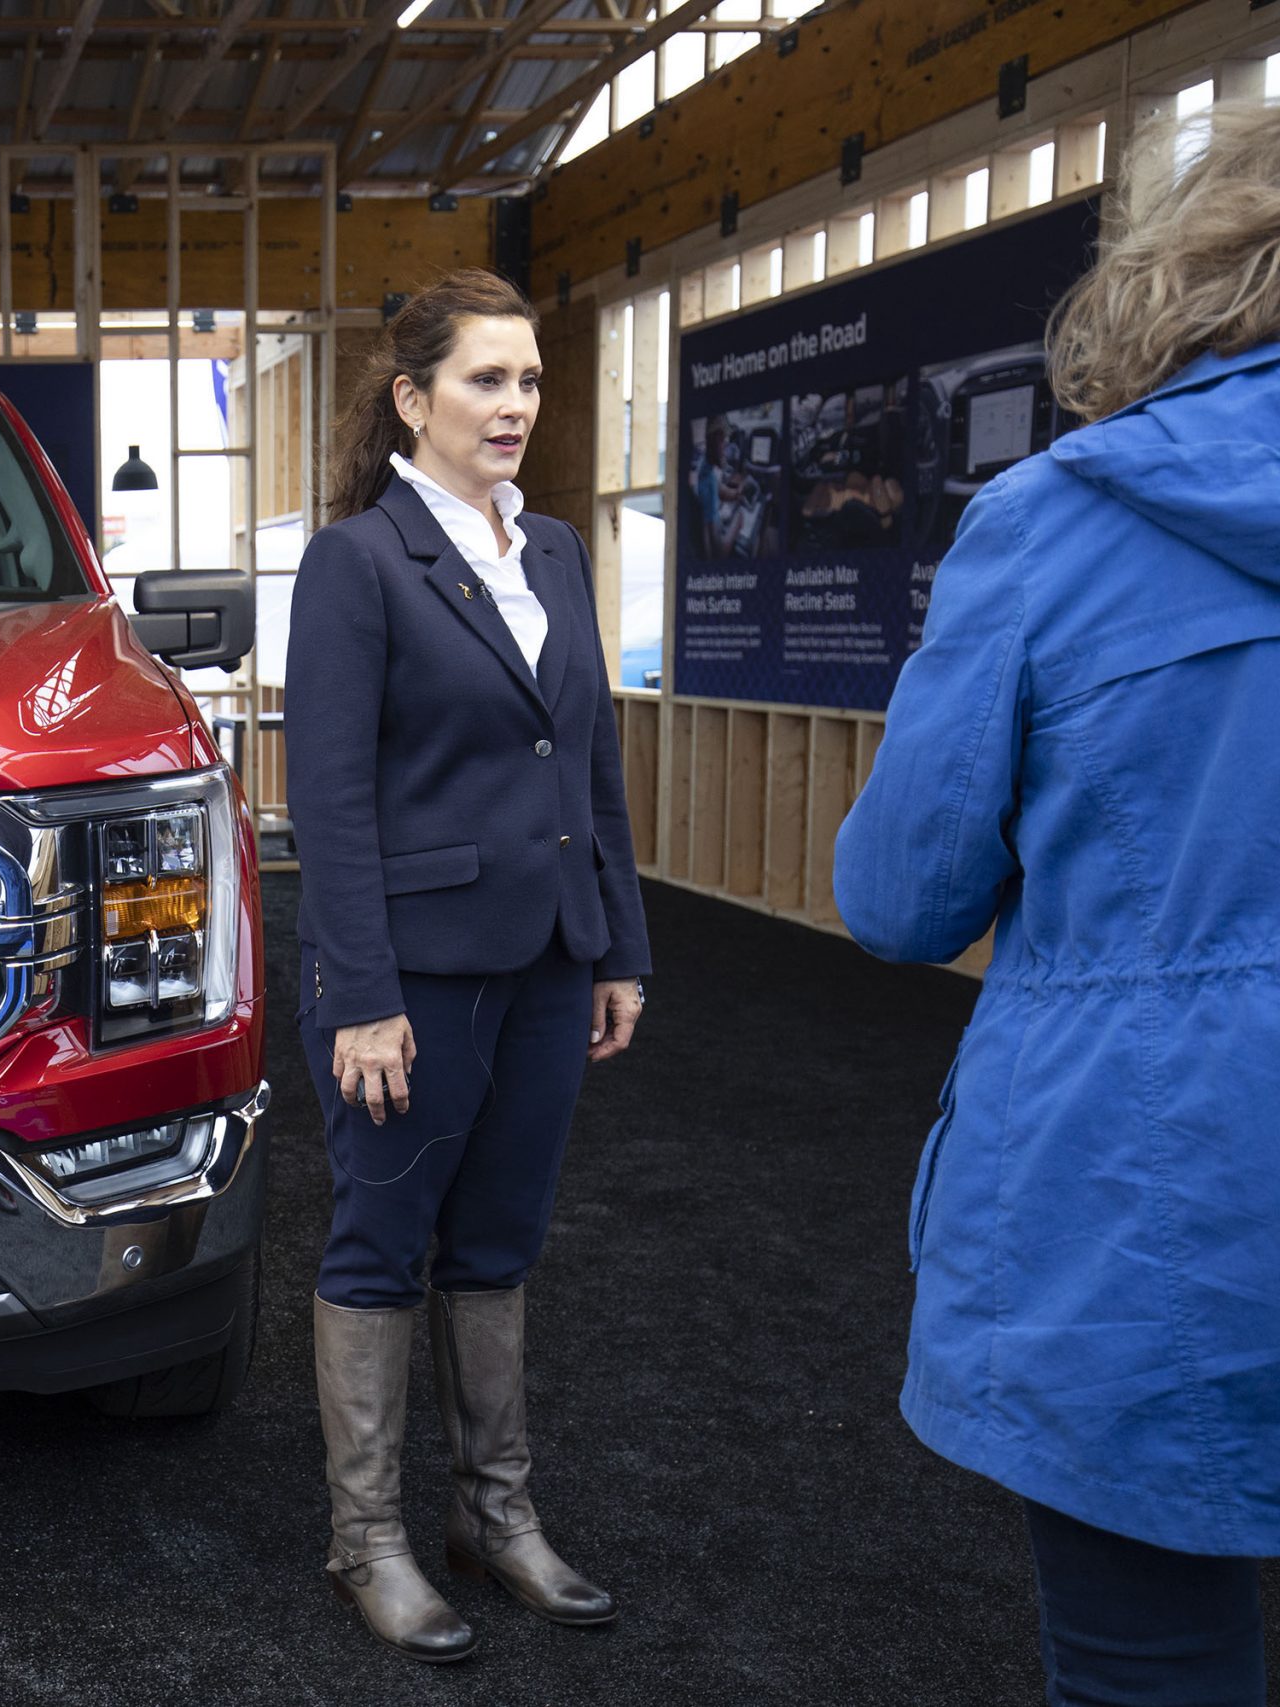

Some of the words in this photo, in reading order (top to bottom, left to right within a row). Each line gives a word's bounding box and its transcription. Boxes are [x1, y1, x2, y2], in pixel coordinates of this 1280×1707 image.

[692, 362, 723, 388] Your
[722, 349, 766, 381] Home
[768, 342, 788, 368] on
[790, 331, 818, 362] the
[820, 311, 867, 355] Road
[686, 573, 724, 592] Available
[726, 570, 759, 590] Interior
[785, 566, 833, 587] Available
[834, 564, 859, 584] Max
[686, 597, 707, 614] Work
[708, 595, 742, 614] Surface
[784, 592, 823, 611] Recline
[824, 591, 856, 611] Seats
